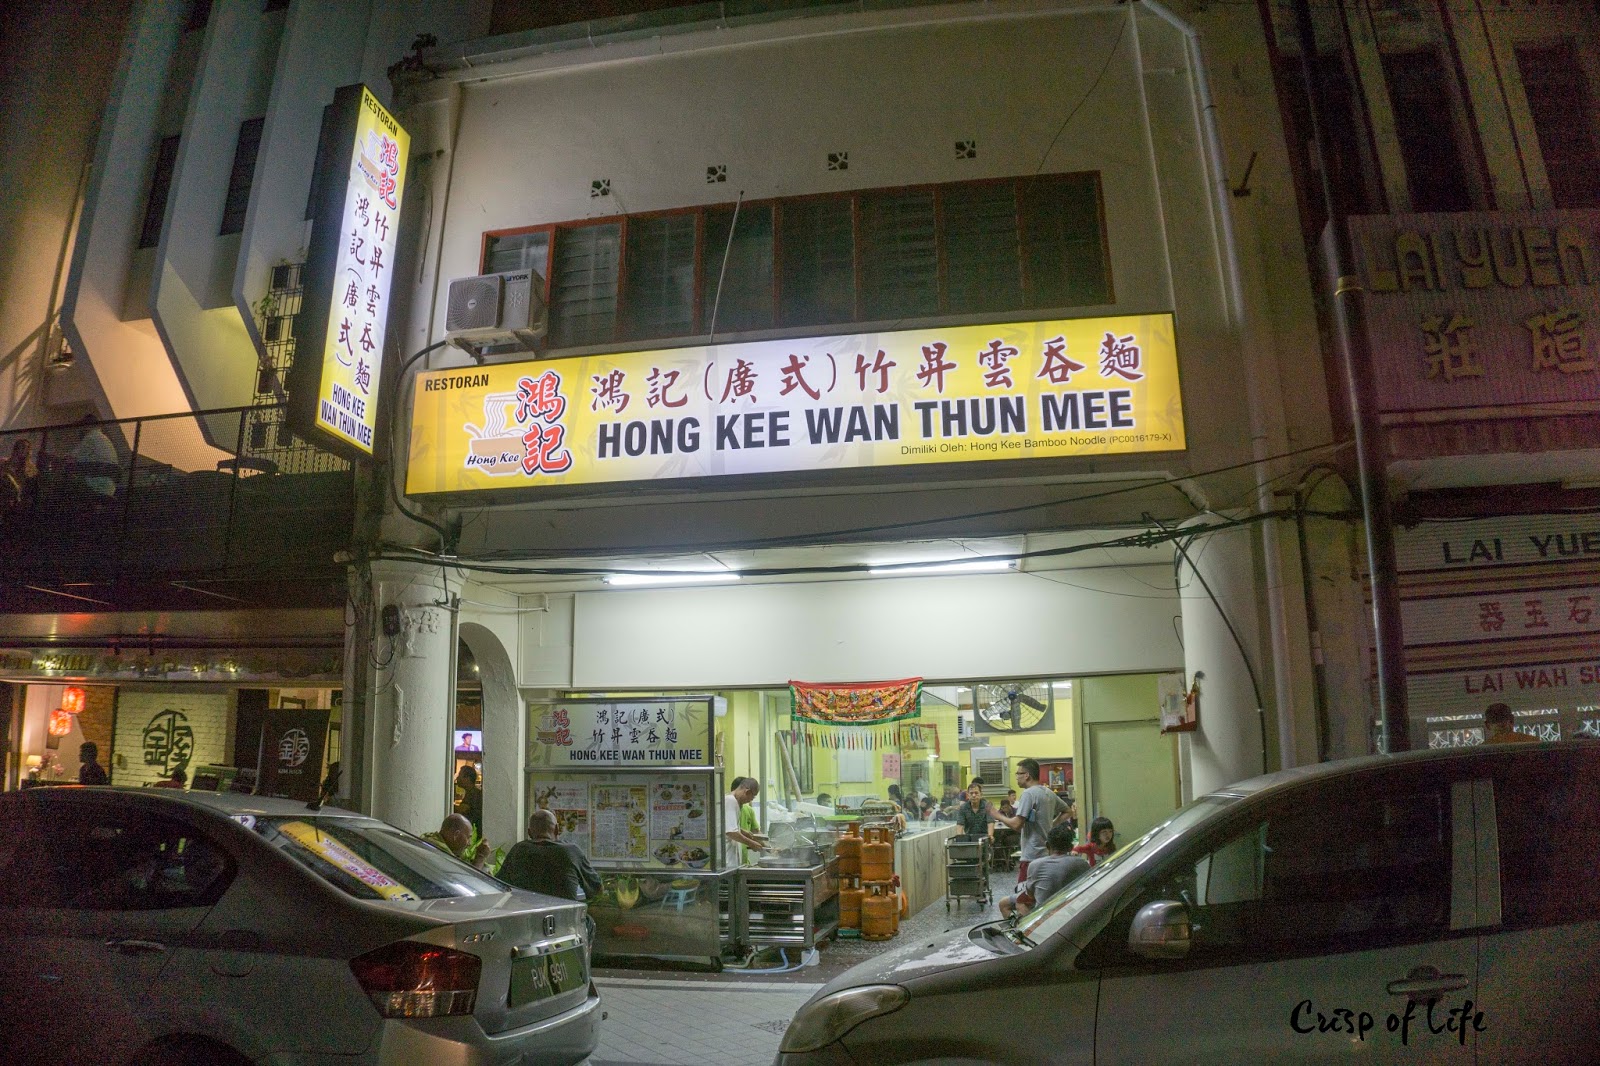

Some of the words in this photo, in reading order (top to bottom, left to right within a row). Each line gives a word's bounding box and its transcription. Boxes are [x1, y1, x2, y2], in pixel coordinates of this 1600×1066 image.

[364, 94, 398, 137] RESTORAN
[379, 135, 399, 210] 鴻記
[425, 374, 489, 392] RESTORAN
[333, 383, 351, 411] HONG
[352, 396, 365, 419] KEE
[321, 399, 338, 426] WAN
[339, 410, 356, 437] THUN
[357, 422, 372, 447] MEE
[516, 371, 572, 474] 鴻記
[598, 416, 701, 459] HONG
[716, 410, 791, 451] KEE
[805, 403, 899, 445] WAN
[915, 395, 1026, 438] THUN
[1042, 390, 1134, 431] MEE
[901, 444, 937, 455] Dimiliki
[940, 442, 967, 453] Oleh:
[970, 440, 998, 453] Hong
[1001, 439, 1021, 449] Kee
[1024, 437, 1067, 448] Bamboo
[1070, 435, 1106, 446] Noodle
[1109, 433, 1172, 445] (PC0016179-X)
[467, 454, 497, 467] Hong
[499, 453, 520, 464] Kee
[1442, 538, 1504, 564] LAI
[1464, 672, 1504, 694] LAI
[1515, 668, 1568, 690] WAH
[553, 708, 573, 746] 鴻記
[570, 750, 597, 761] HONG
[600, 750, 619, 761] KEE
[622, 750, 645, 760] WAN
[649, 749, 676, 760] THUN
[679, 749, 702, 760] MEE
[531, 967, 551, 989] PJK
[550, 963, 568, 983] 9911
